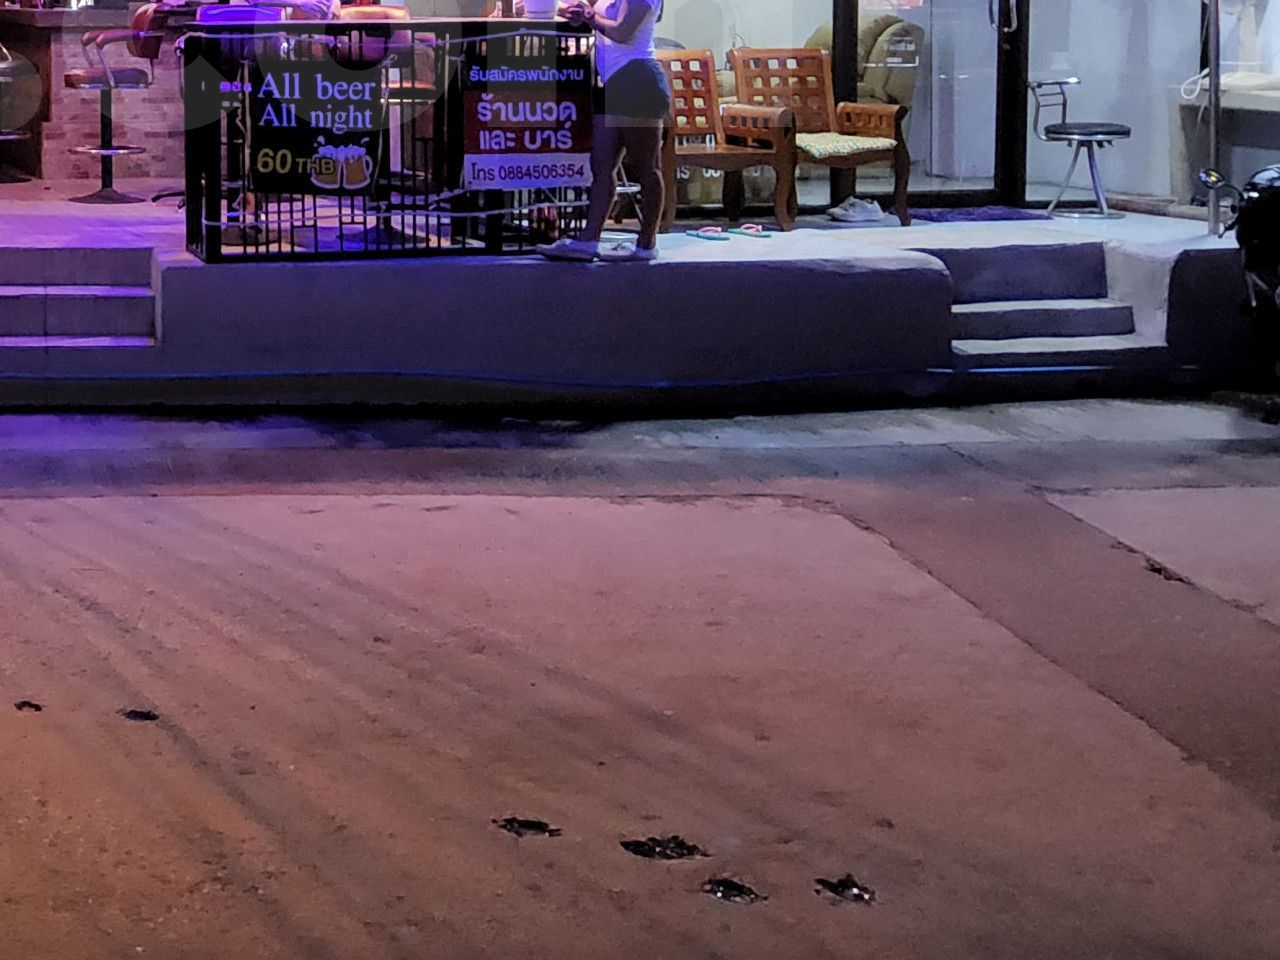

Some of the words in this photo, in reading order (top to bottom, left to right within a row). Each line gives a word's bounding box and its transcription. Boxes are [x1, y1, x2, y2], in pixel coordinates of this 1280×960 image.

[257, 72, 301, 99] All
[315, 73, 376, 100] beer
[469, 65, 584, 81] รับสมัครพนักงาน
[258, 103, 297, 127] All
[310, 104, 373, 134] night
[477, 93, 577, 121] ร้านนวด
[479, 130, 516, 150] และ
[524, 121, 573, 150] บาร์
[257, 148, 291, 174] 60
[295, 158, 335, 174] THB
[471, 162, 495, 181] โทร
[498, 164, 585, 181] 0884506354
